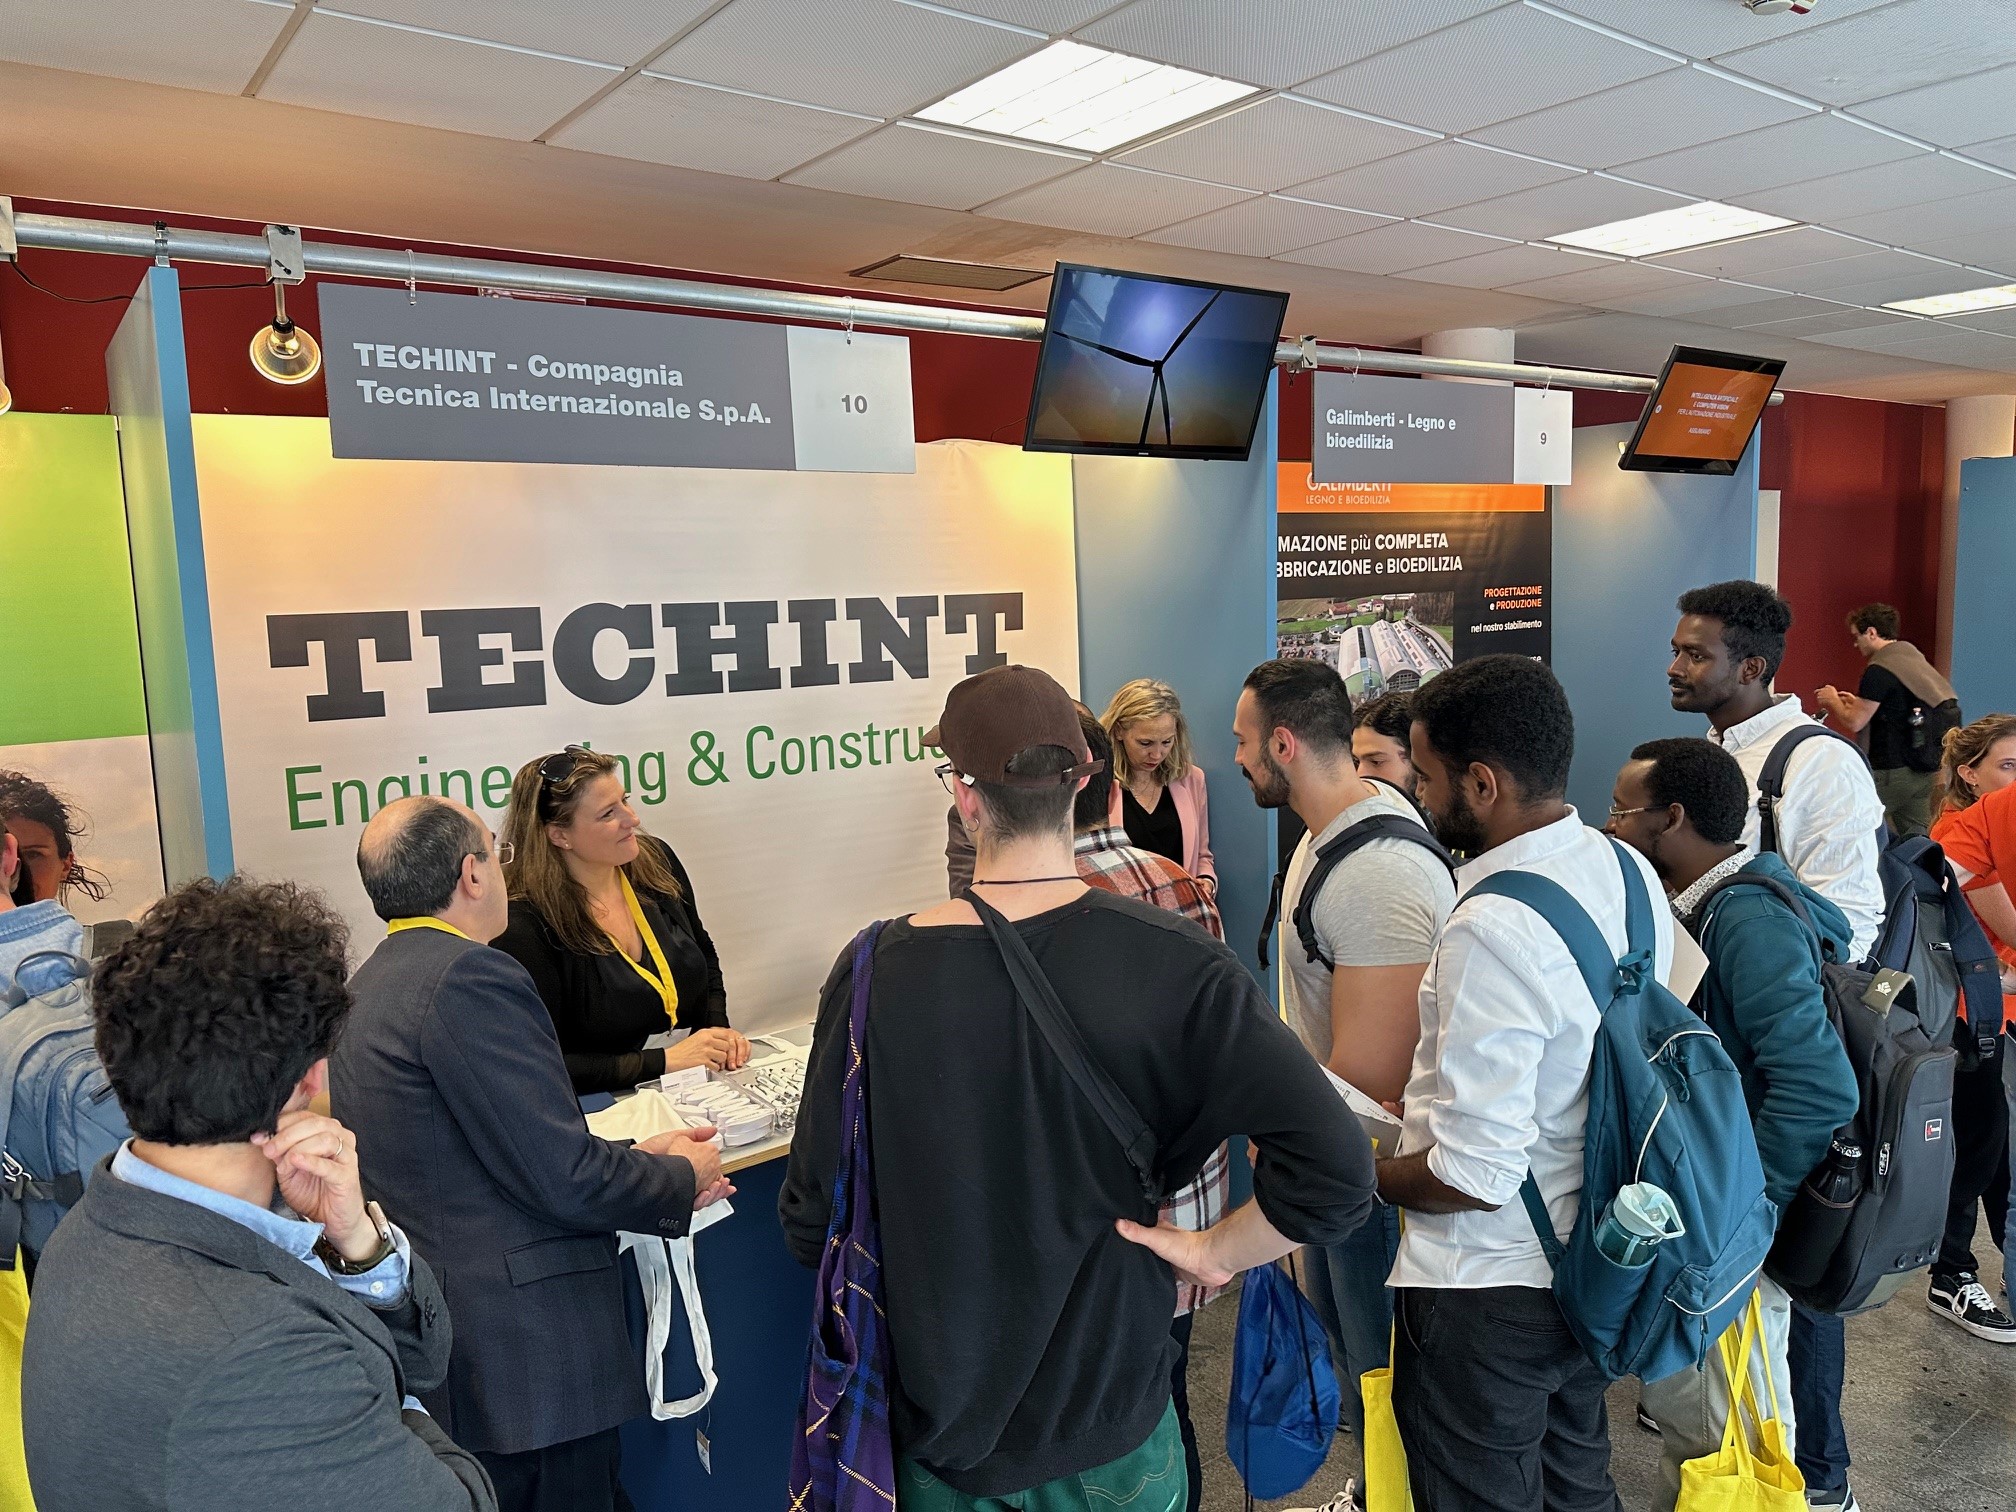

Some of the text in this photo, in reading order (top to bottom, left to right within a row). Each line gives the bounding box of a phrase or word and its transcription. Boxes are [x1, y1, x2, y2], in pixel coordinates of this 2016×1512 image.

[353, 341, 496, 374] TECHINT
[527, 353, 683, 388] Compagnia
[357, 378, 771, 426] Tecnica Internazionale S.p.A.
[841, 394, 867, 414] 10
[1326, 408, 1395, 428] Galimberti
[1407, 413, 1445, 432] Legno
[1448, 419, 1456, 430] e
[1326, 432, 1394, 450] bioedilizia
[1540, 432, 1547, 445] 9
[1306, 495, 1391, 505] LEGNO E BIOEDILIZIA
[1278, 532, 1449, 554] MAZIONE più COMPLETA
[1375, 562, 1384, 574] e
[1387, 556, 1463, 574] BIOEDILIZIA
[1484, 586, 1542, 598] PROGETTAZIONE
[1489, 598, 1542, 611] e PRODUZIONE
[1471, 619, 1542, 633] nel nostro stabilimento
[267, 592, 1024, 722] TECHINT
[687, 729, 730, 786] &
